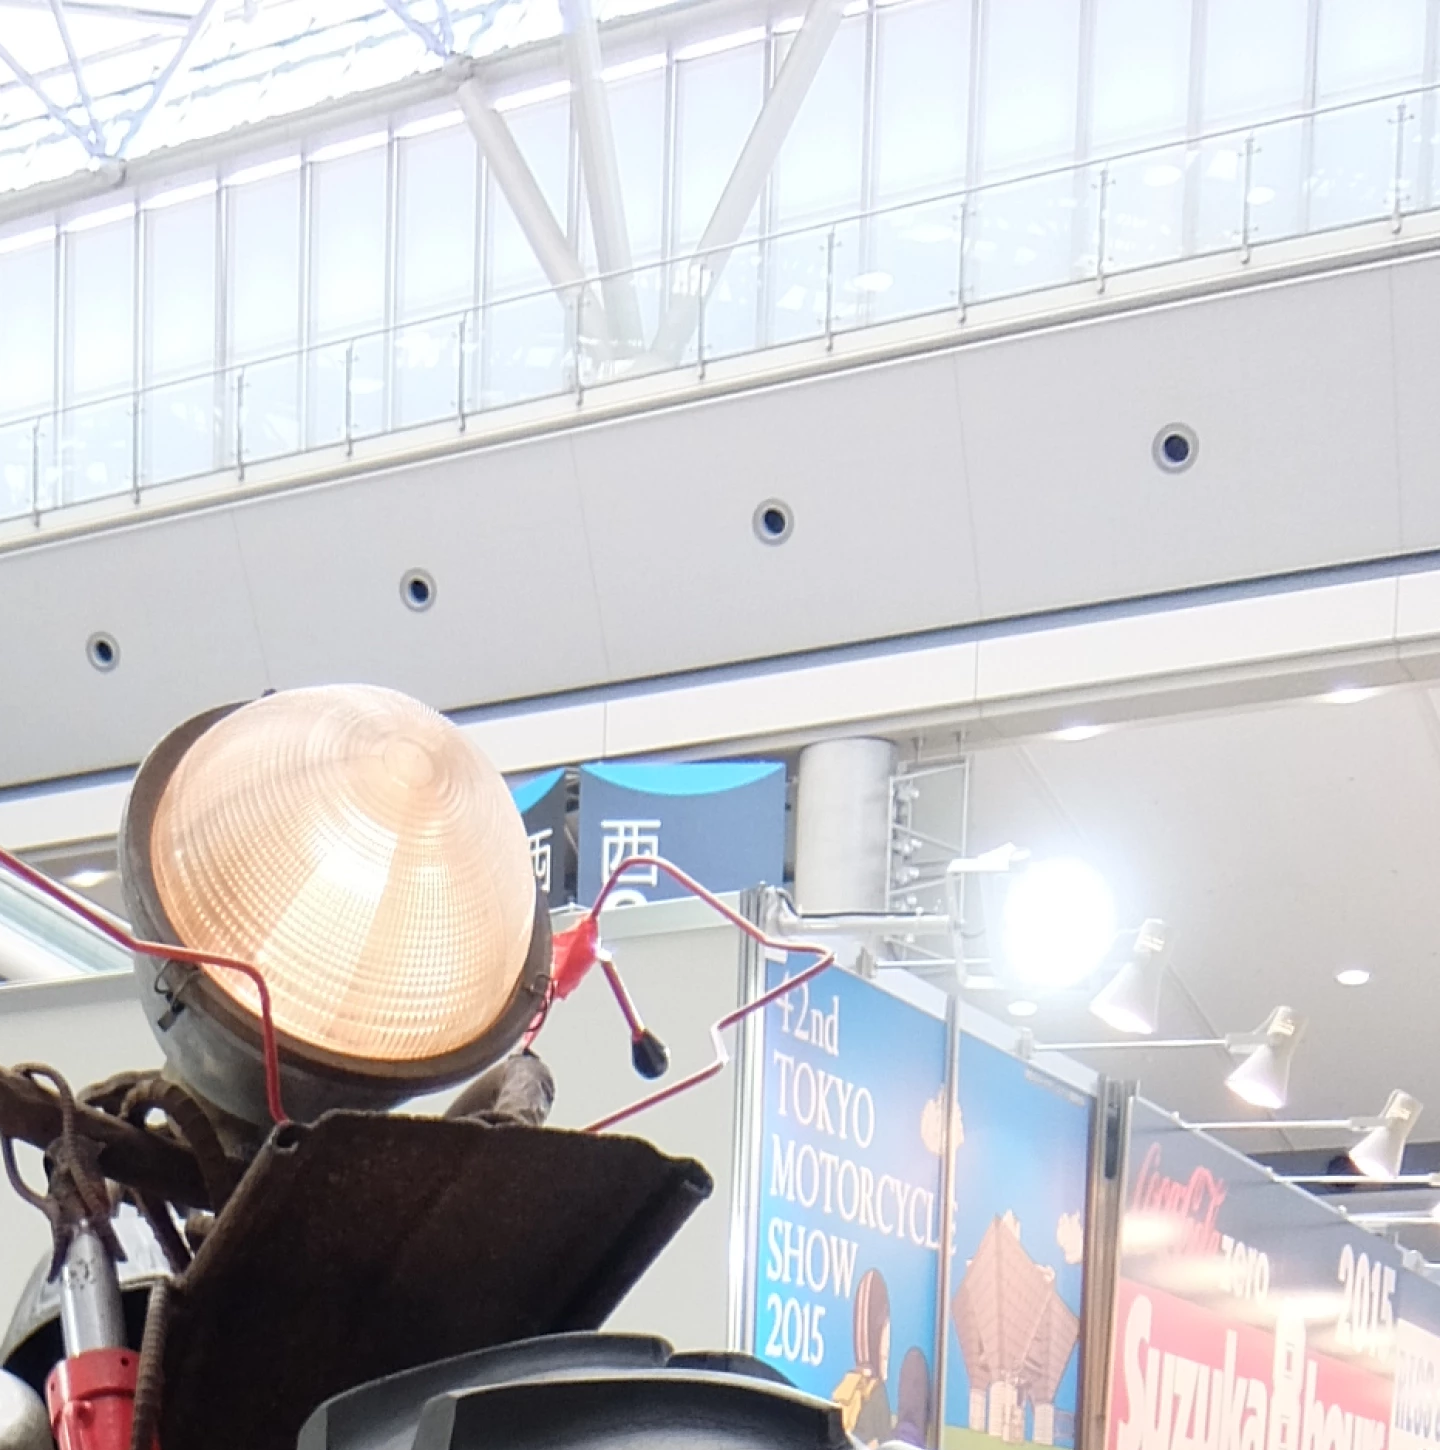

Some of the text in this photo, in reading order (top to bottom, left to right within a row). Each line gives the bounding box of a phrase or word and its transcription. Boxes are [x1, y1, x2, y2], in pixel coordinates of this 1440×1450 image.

[600, 819, 662, 887] 西
[774, 970, 840, 1057] 42nd
[773, 1049, 875, 1149] TOKYO
[766, 1216, 859, 1299] SHOW
[764, 1292, 826, 1367] 2015
[1336, 1243, 1397, 1362] 2015
